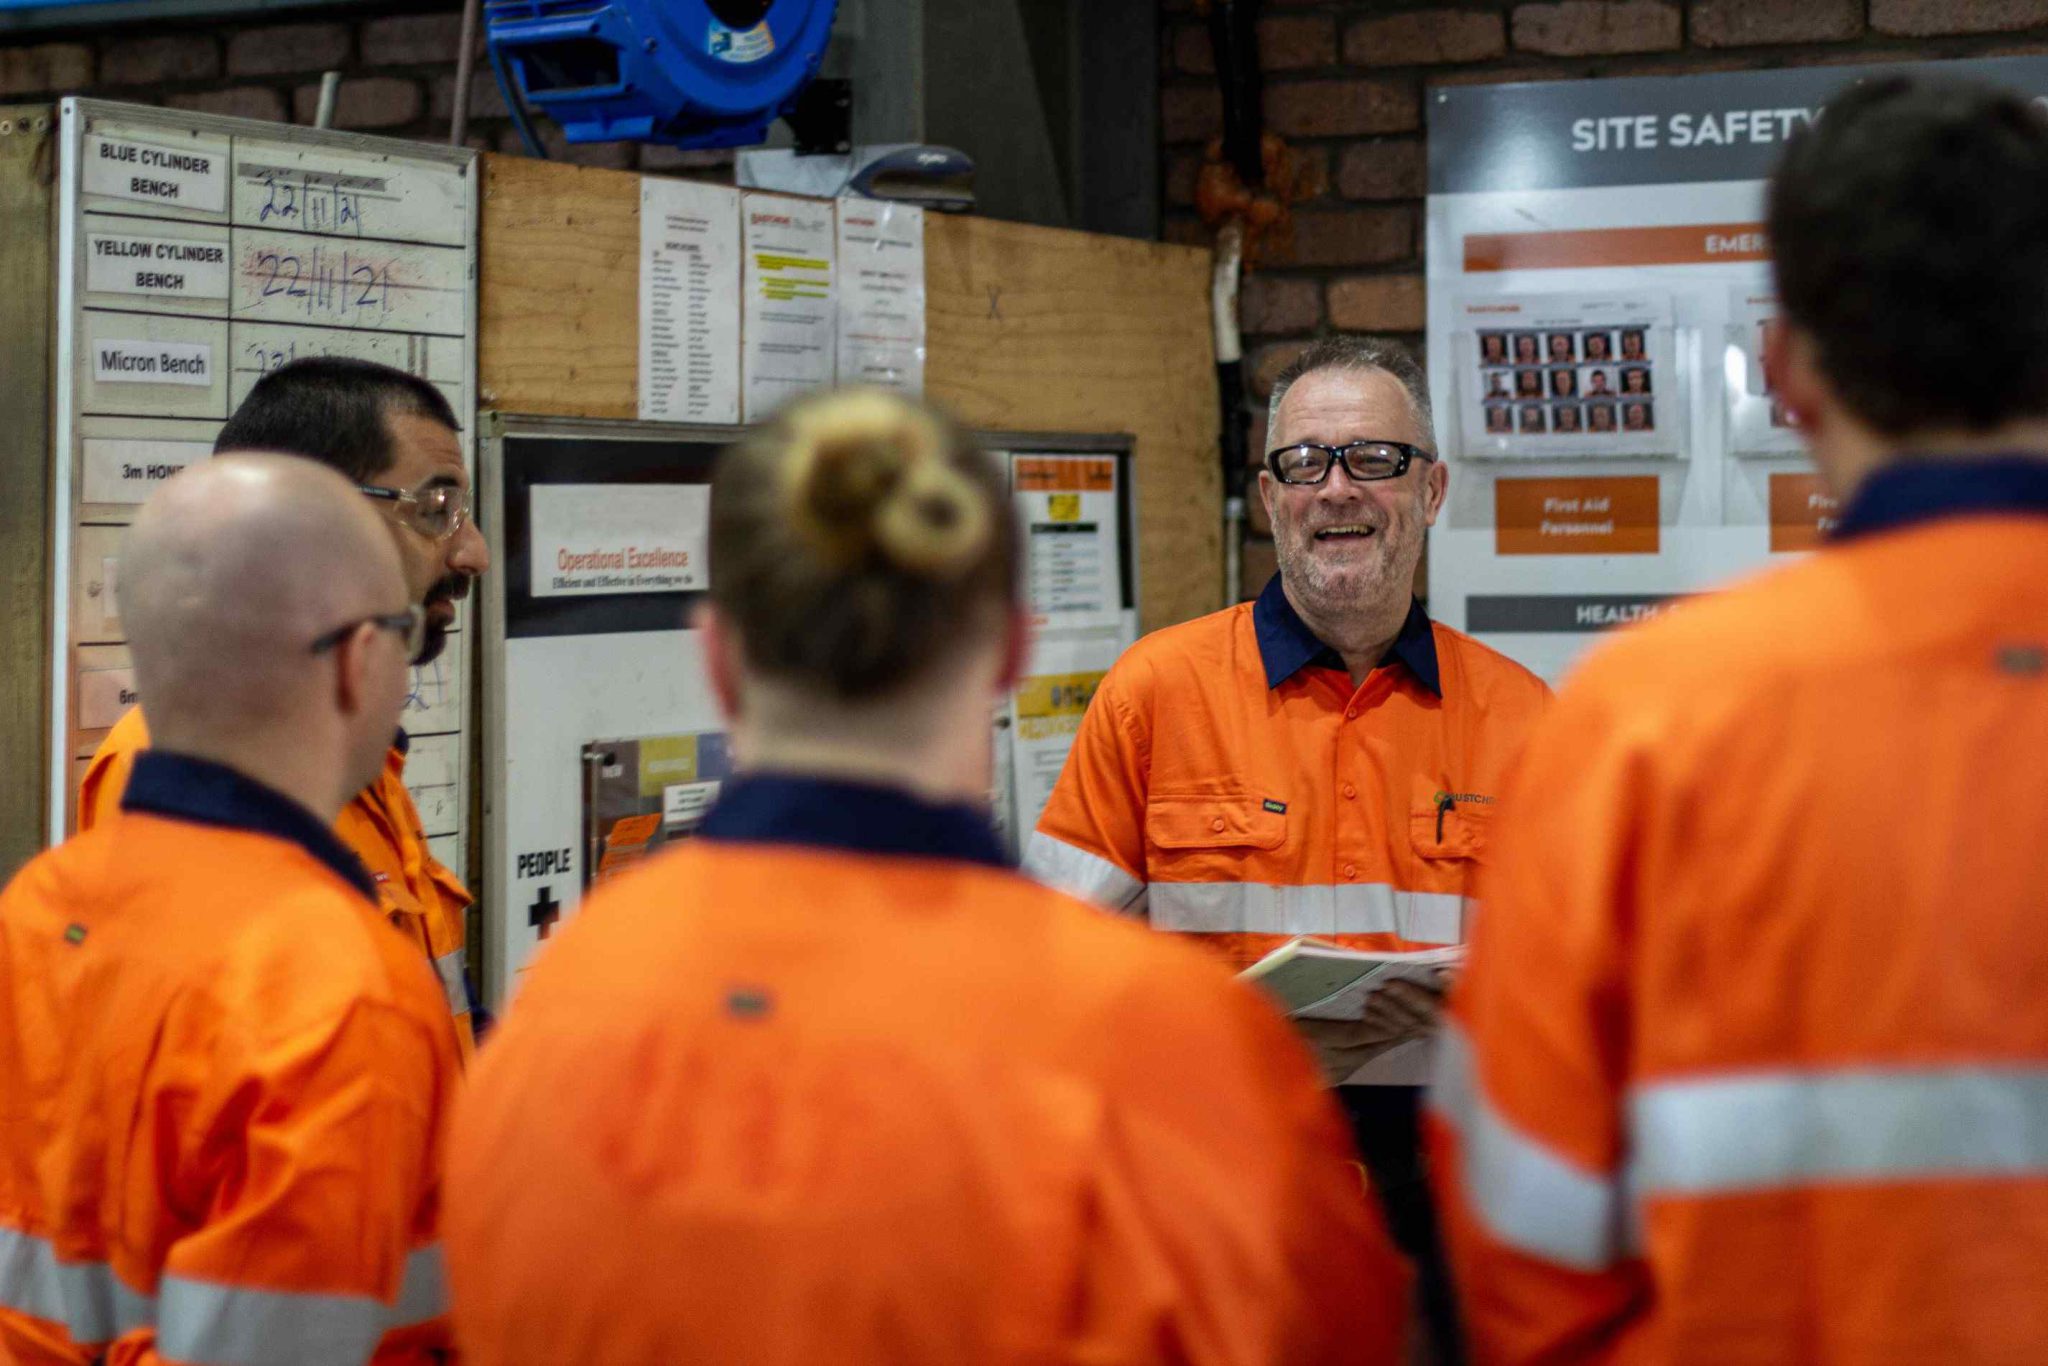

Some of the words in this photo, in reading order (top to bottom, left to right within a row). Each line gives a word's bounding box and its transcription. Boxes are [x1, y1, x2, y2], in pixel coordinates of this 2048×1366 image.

[1572, 114, 1659, 152] SITE
[99, 142, 137, 163] BLUE
[140, 149, 210, 175] CYLINDER
[130, 176, 179, 199] BENCH
[94, 239, 153, 260] YELLOW
[155, 243, 224, 264] CYLINDER
[1704, 233, 1767, 255] EMER
[135, 271, 184, 291] BENCH
[101, 350, 155, 372] Micron
[160, 353, 205, 375] Bench
[122, 463, 143, 480] 3m
[1543, 497, 1579, 513] First
[1582, 496, 1611, 513] Aid
[1540, 520, 1614, 536] Personnel
[558, 548, 625, 573] Operational
[627, 547, 689, 568] Excellence
[517, 848, 572, 879] PEOPLE
